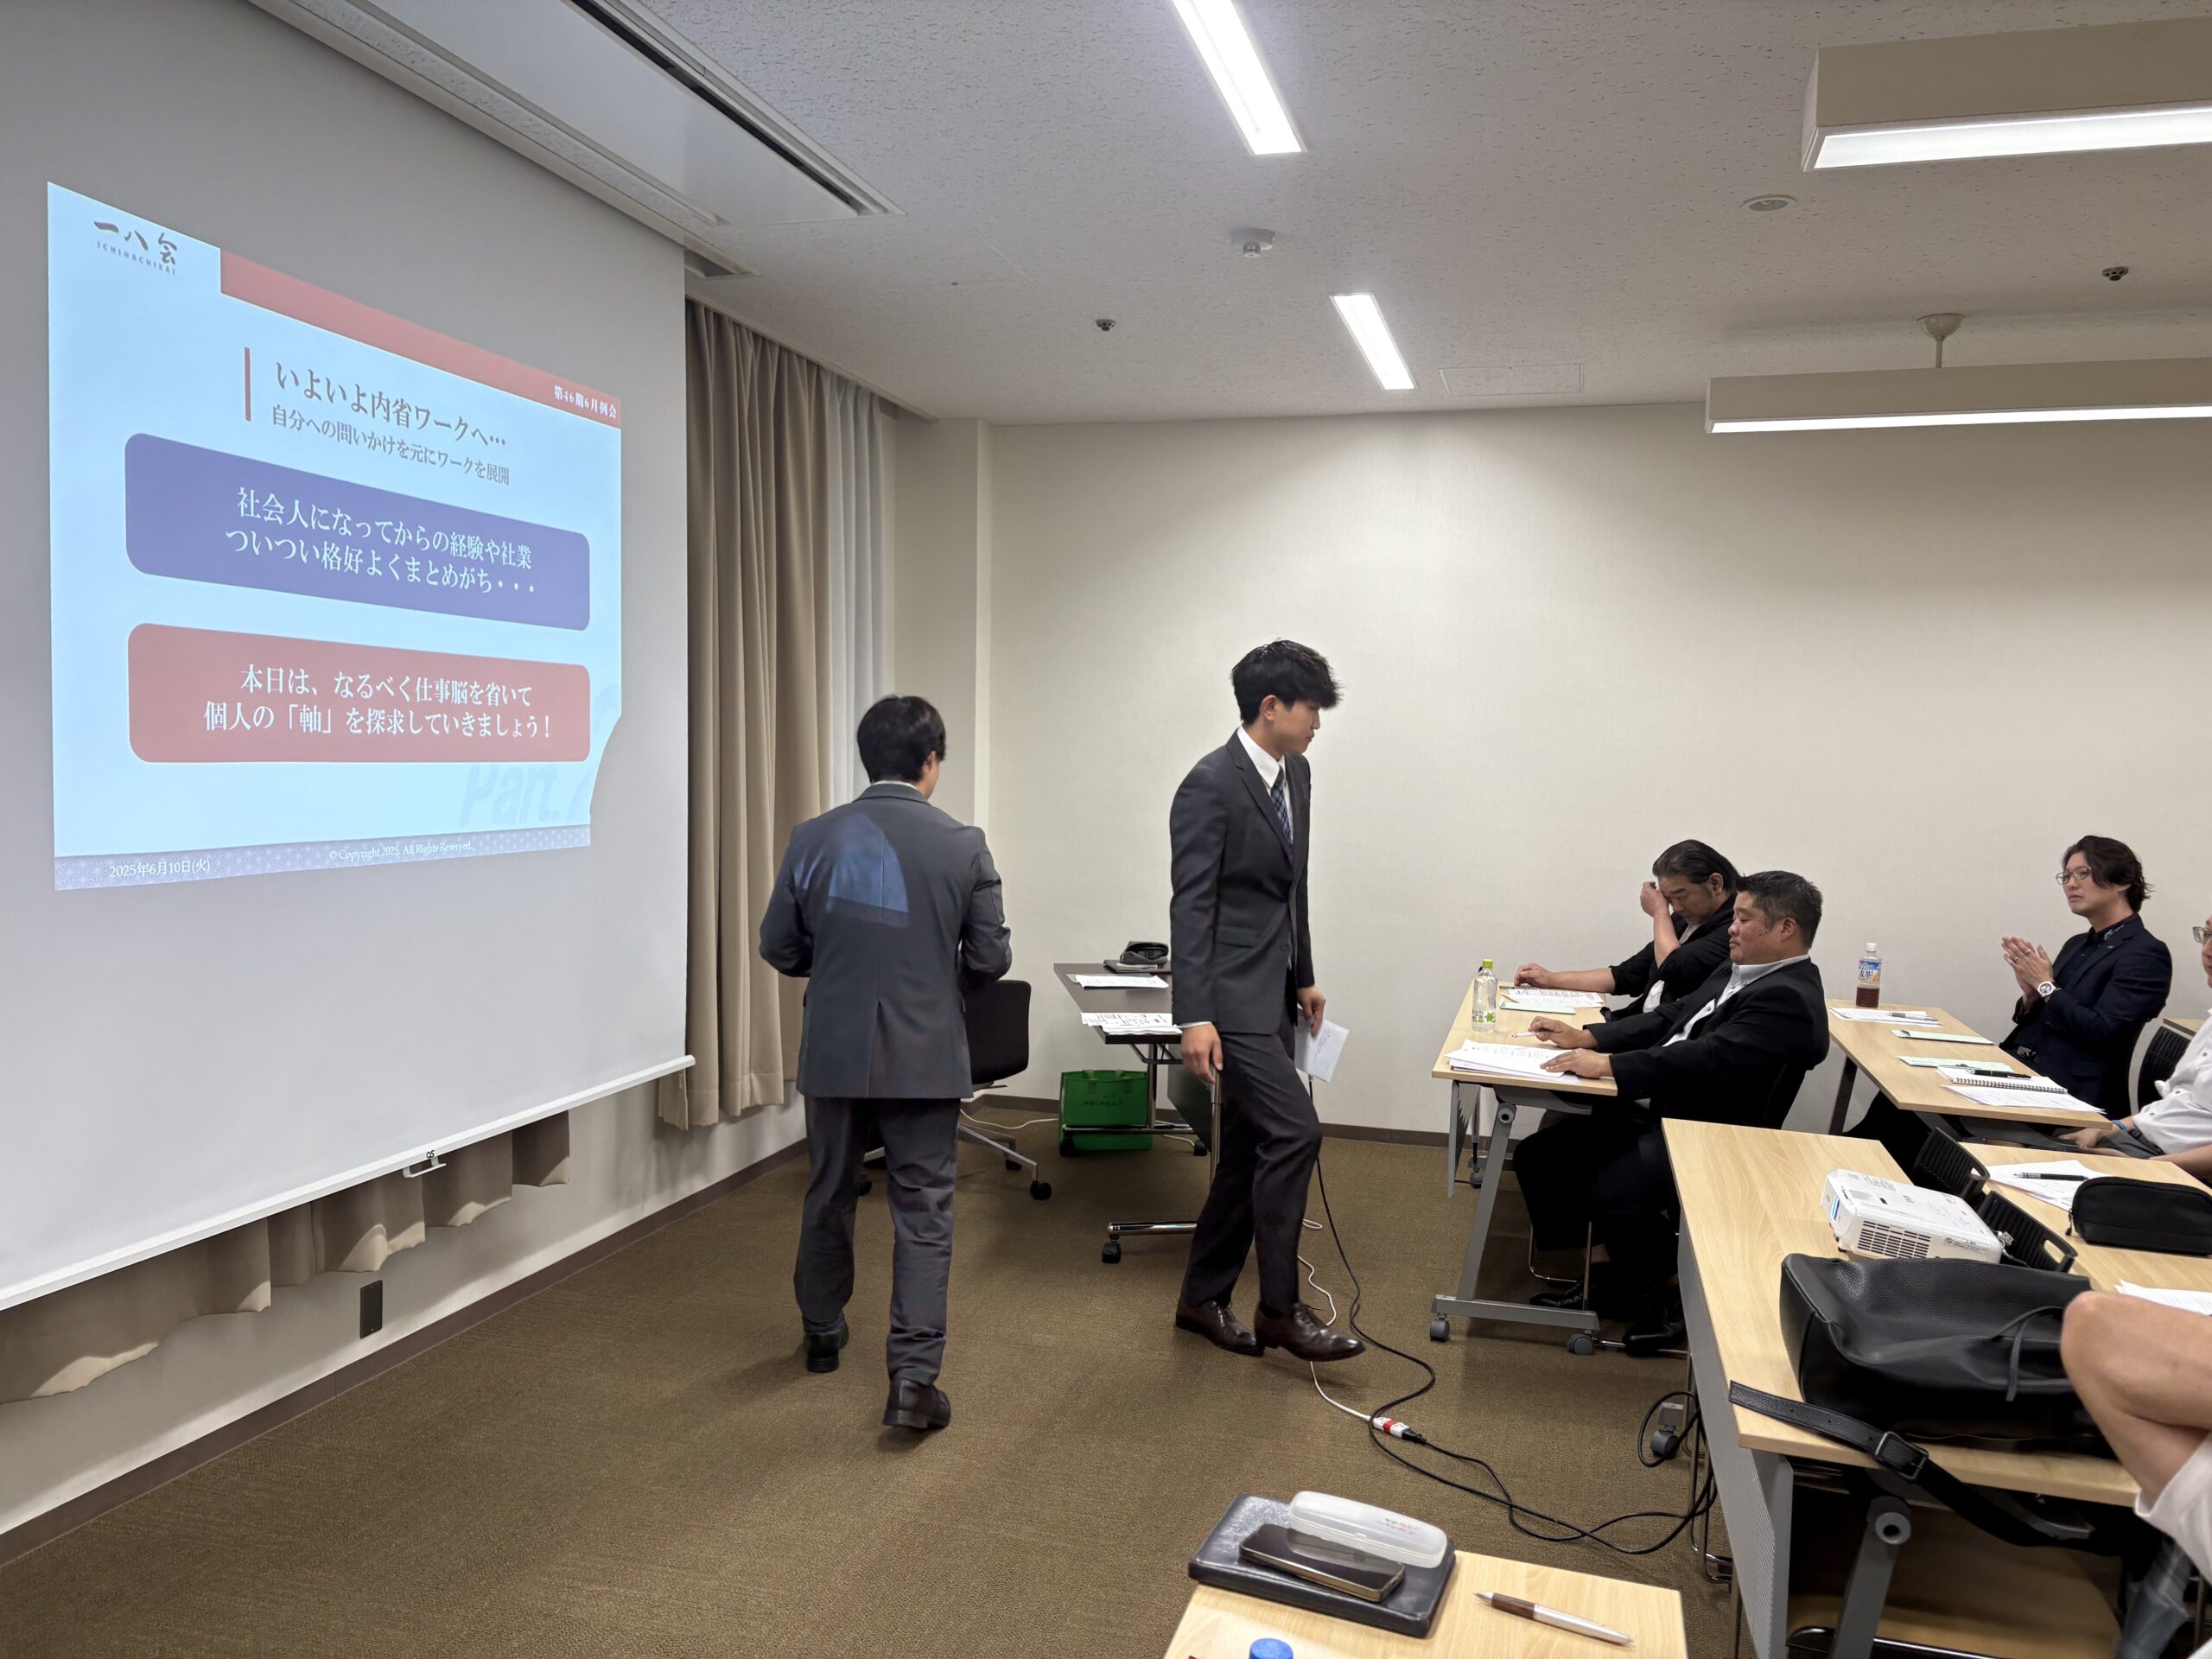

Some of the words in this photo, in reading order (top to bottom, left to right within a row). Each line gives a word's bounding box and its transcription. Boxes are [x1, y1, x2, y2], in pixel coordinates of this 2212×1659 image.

[93, 221, 177, 265] 一八会
[97, 240, 175, 276] ICHIHACHIKAI
[554, 385, 617, 419] 第46期6月例会
[272, 404, 510, 486] 自分への問いかけを元にワークを展開
[237, 486, 531, 569] 社会人になってからの経験や社業
[109, 858, 211, 878] 2025年6月10日(火)
[339, 849, 380, 862] Copyright
[404, 844, 415, 855] All
[416, 842, 439, 857] Rights
